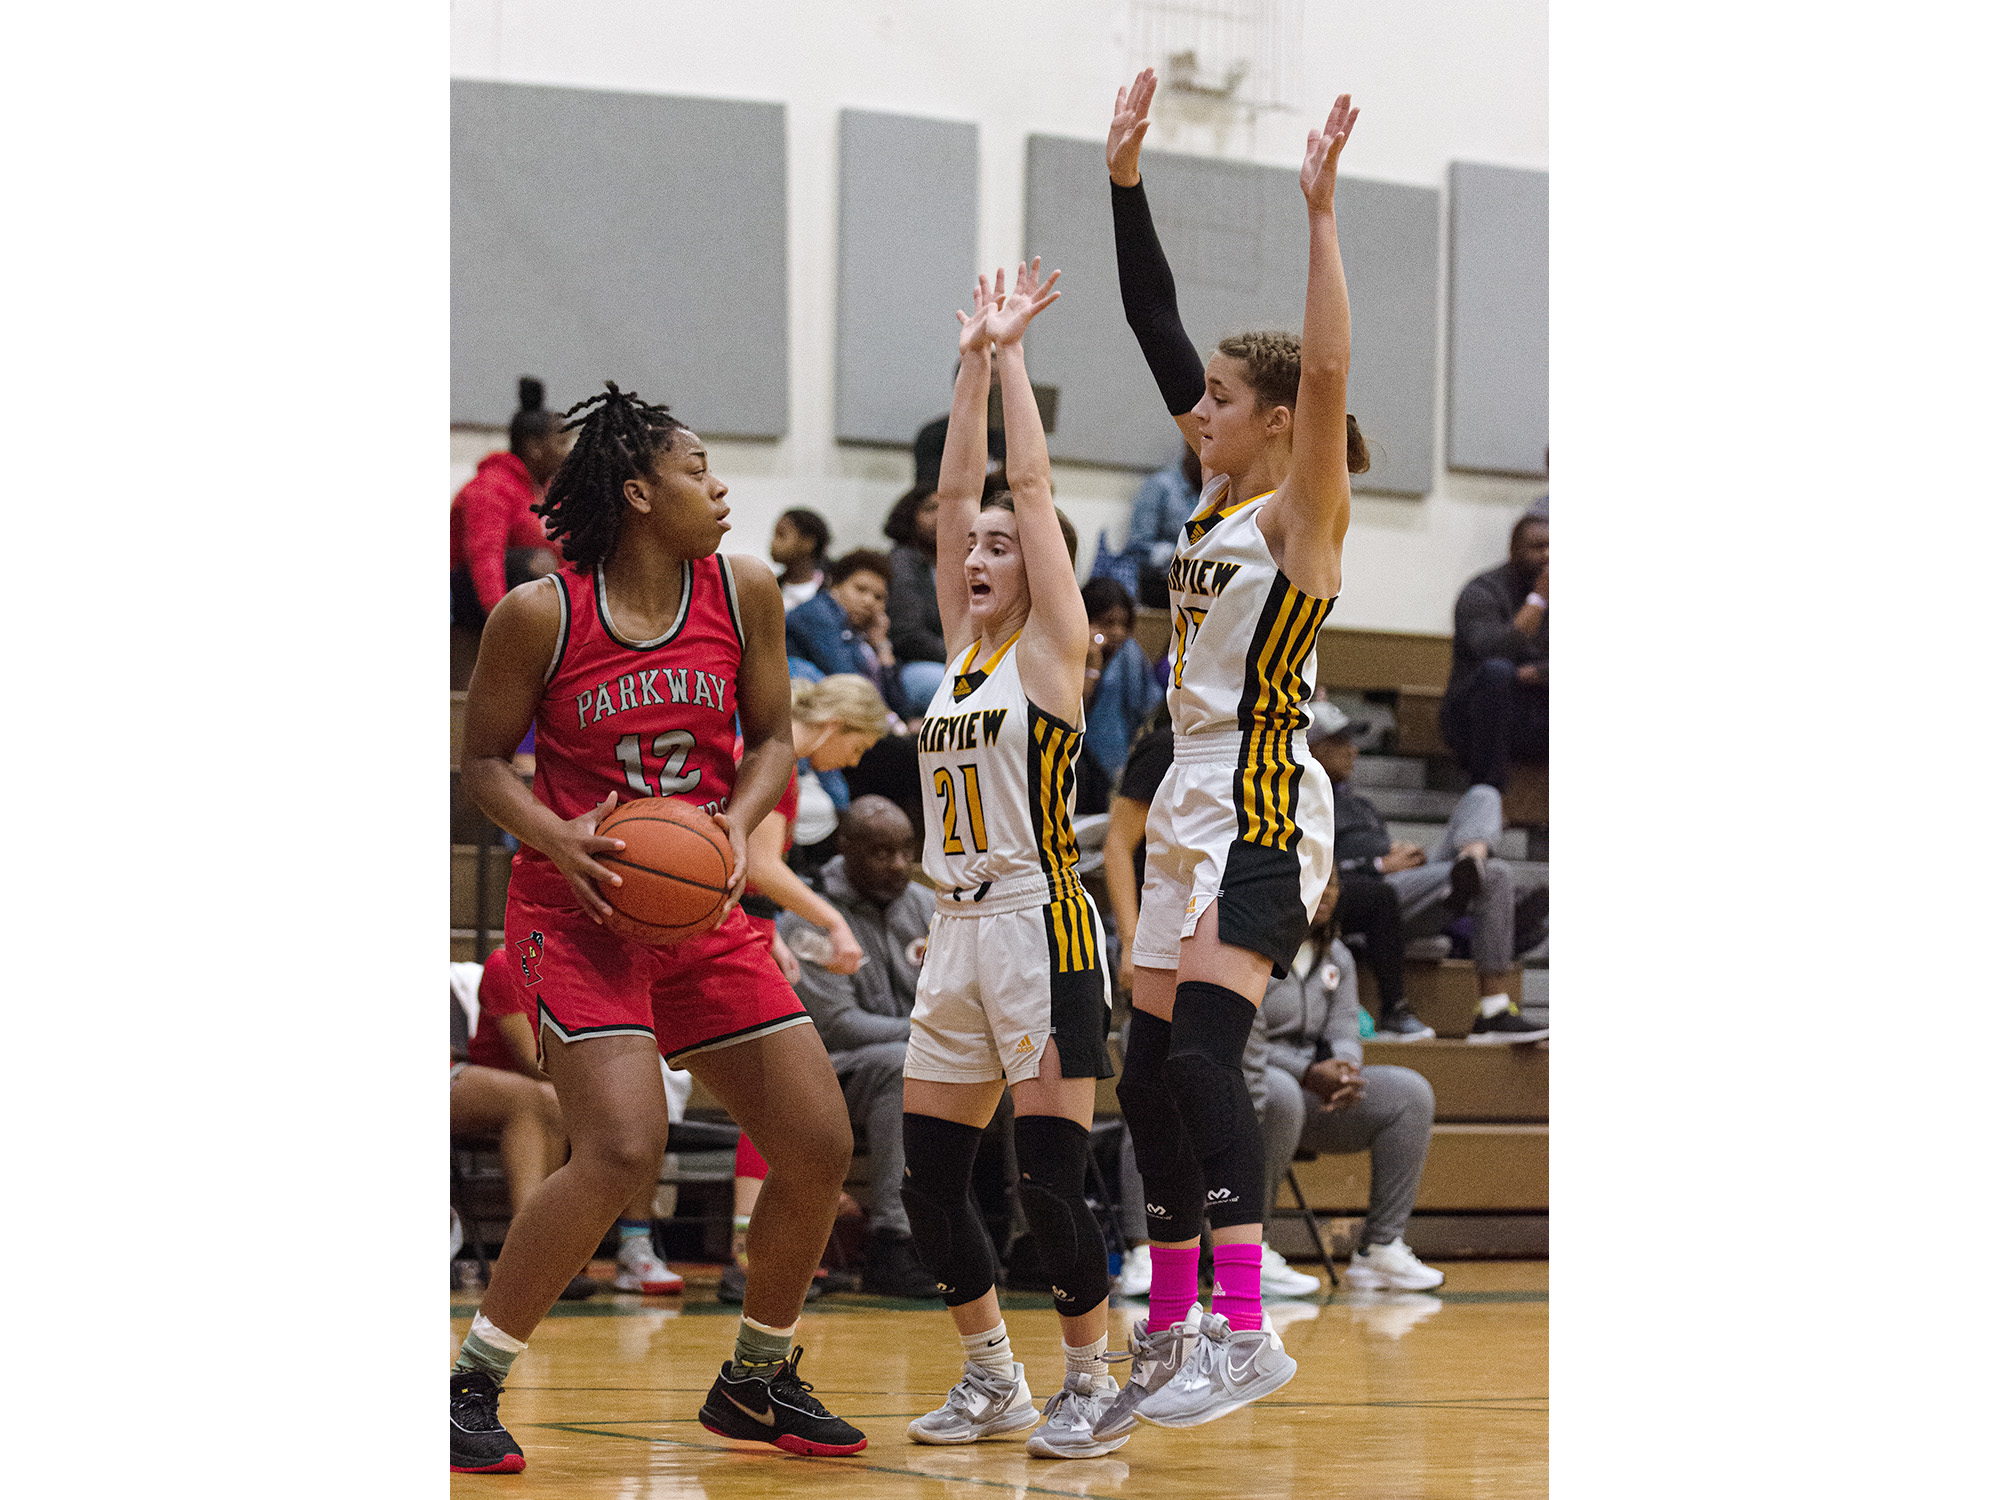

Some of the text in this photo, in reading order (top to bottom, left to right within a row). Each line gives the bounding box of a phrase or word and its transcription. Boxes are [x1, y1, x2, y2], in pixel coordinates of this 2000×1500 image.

[576, 668, 726, 730] PARKWAY
[919, 708, 1008, 753] AIRVIEW
[614, 729, 702, 798] 12
[933, 763, 988, 856] 21
